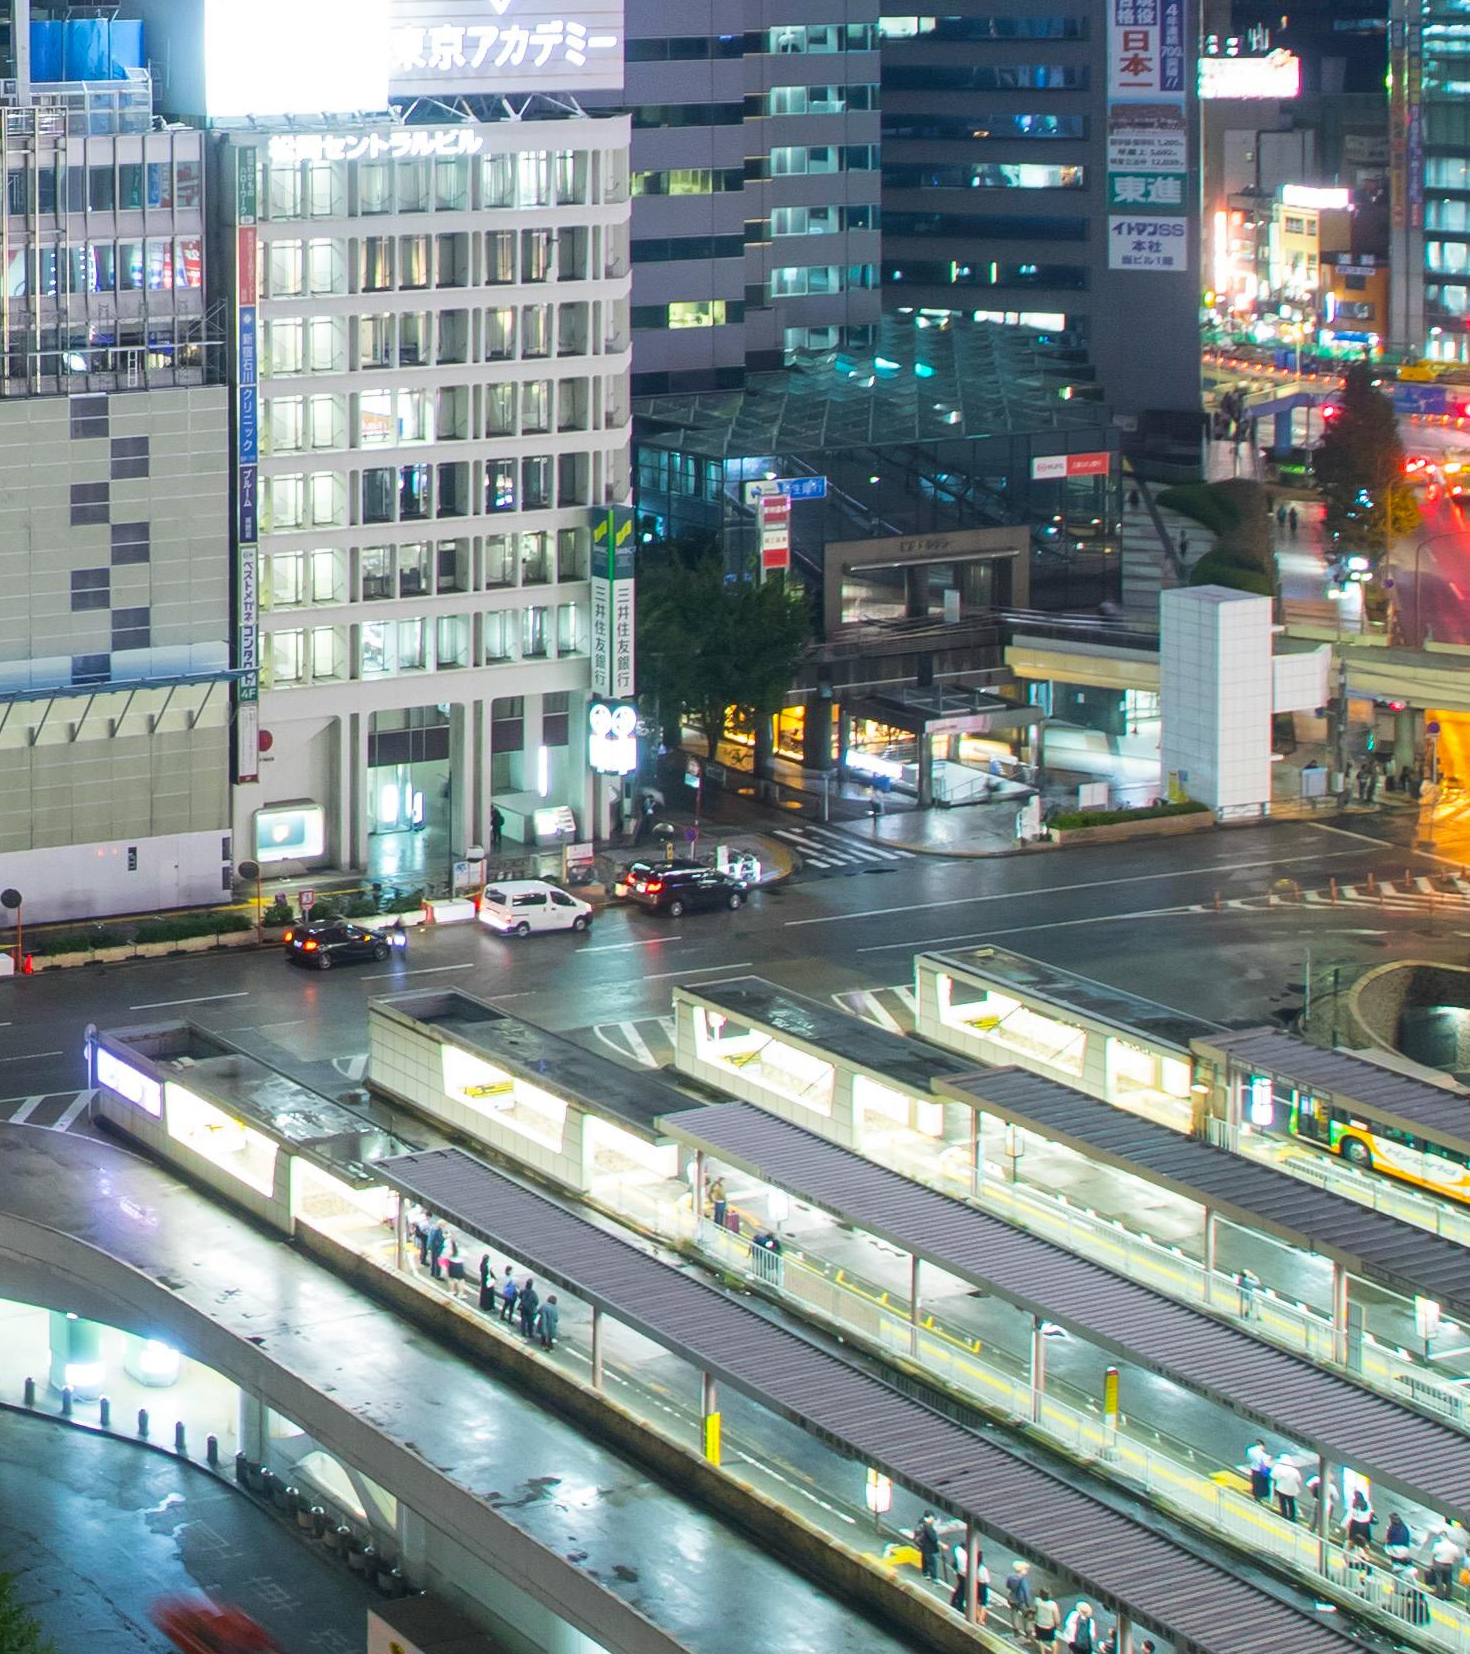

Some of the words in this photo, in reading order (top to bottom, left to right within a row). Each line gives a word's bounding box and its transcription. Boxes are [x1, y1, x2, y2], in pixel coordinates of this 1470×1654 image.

[388, 19, 617, 72] 東京アカデミー
[1119, 30, 1153, 87] 日本一
[1114, 176, 1181, 204] 東進
[1131, 240, 1163, 253] 本社
[243, 469, 253, 507] ブルーム
[595, 585, 607, 686] 三井住友銀行
[617, 587, 630, 688] 三井住友銀行
